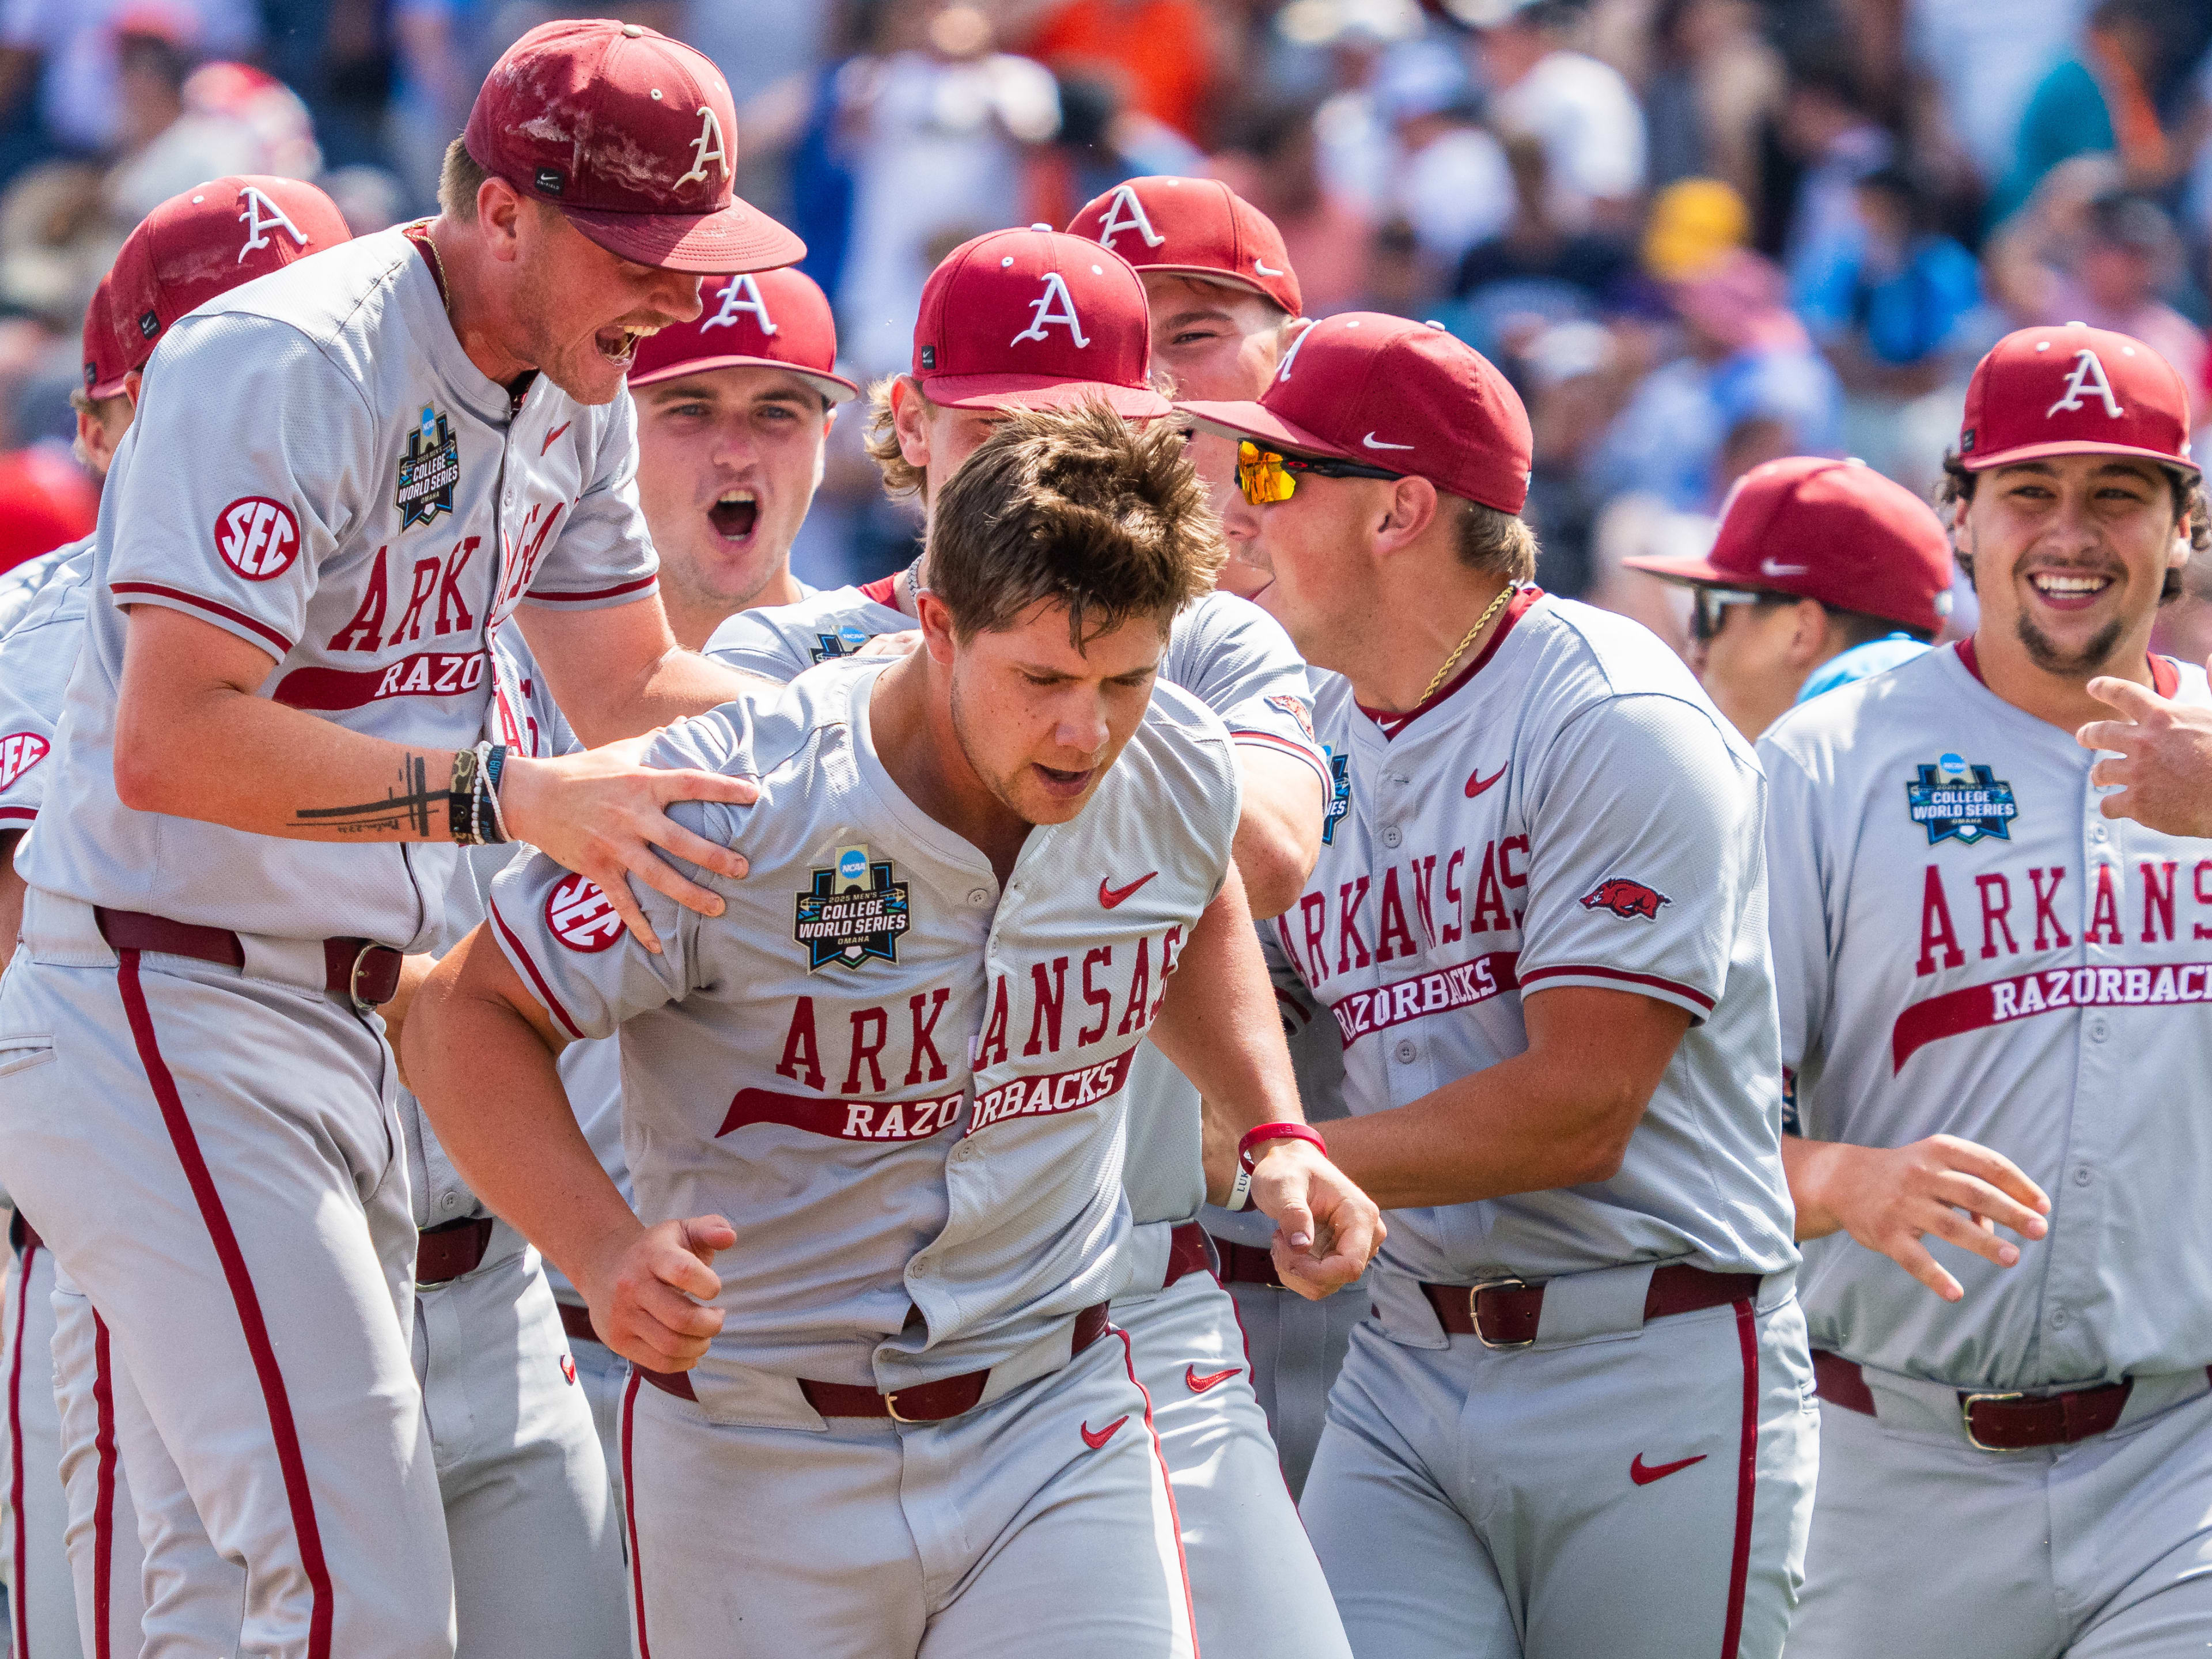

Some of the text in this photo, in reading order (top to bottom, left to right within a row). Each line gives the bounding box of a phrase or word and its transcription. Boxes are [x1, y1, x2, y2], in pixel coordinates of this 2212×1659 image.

[673, 107, 730, 191] A
[238, 186, 308, 264] A
[1099, 185, 1165, 249] A
[700, 274, 778, 336] A
[1010, 272, 1090, 349] A
[2047, 349, 2123, 418] A
[398, 464, 459, 503] WORLD SERIES
[413, 452, 446, 482] COLLEGE
[421, 491, 440, 504] OMAHA
[221, 501, 294, 575] SEC
[0, 736, 44, 787] EC
[1912, 803, 2014, 820] WORLD SERIES
[1931, 790, 1990, 804] COLLEGE
[841, 862, 866, 873] NCAA
[550, 875, 622, 946] SEC
[821, 899, 884, 921] COLLEGE
[828, 891, 877, 904] 2025 MEN'S
[798, 914, 907, 939] WORLD SERIES
[837, 935, 870, 945] OMAHA
[1991, 965, 2212, 1021] RAZORBAC
[1237, 1171, 1249, 1193] LUK
